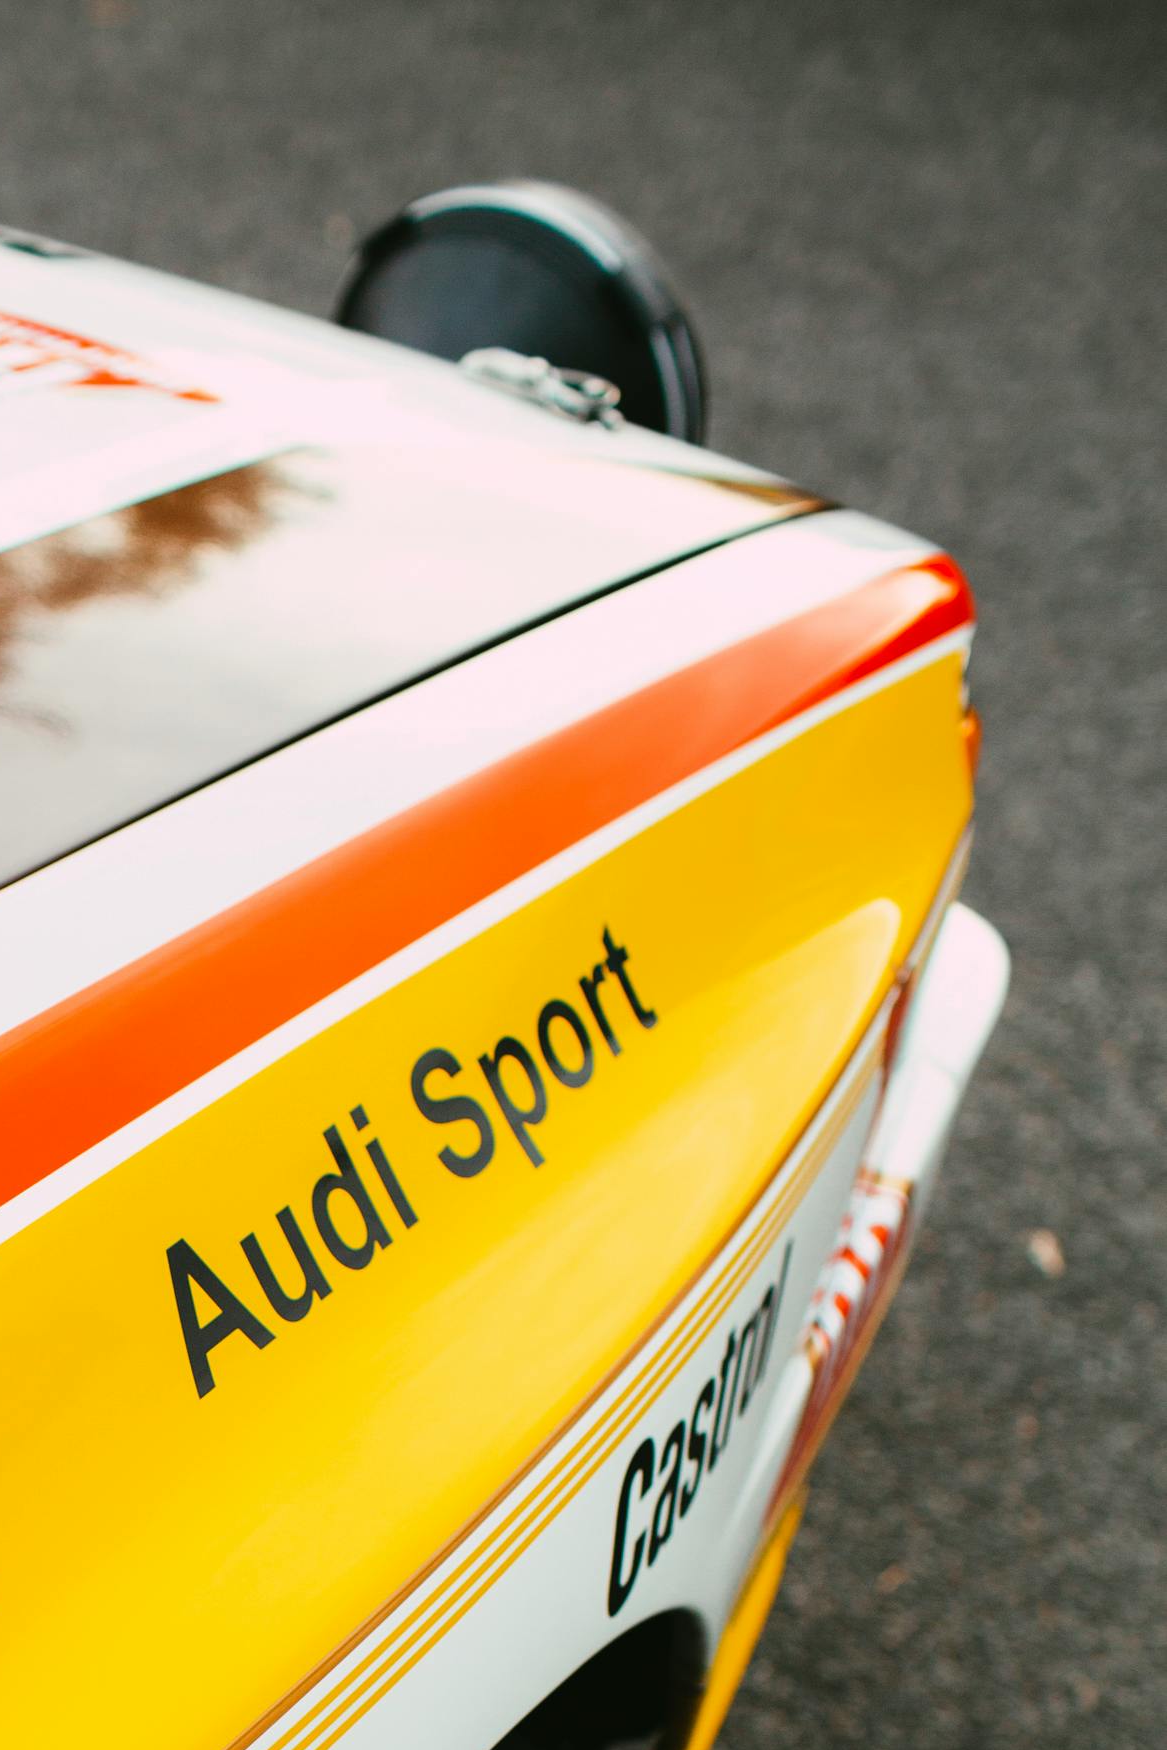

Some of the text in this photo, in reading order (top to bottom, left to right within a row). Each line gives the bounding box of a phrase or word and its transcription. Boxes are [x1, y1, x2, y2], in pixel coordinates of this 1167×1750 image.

[165, 923, 658, 1400] Audi Sport
[606, 1238, 793, 1618] Castrol
